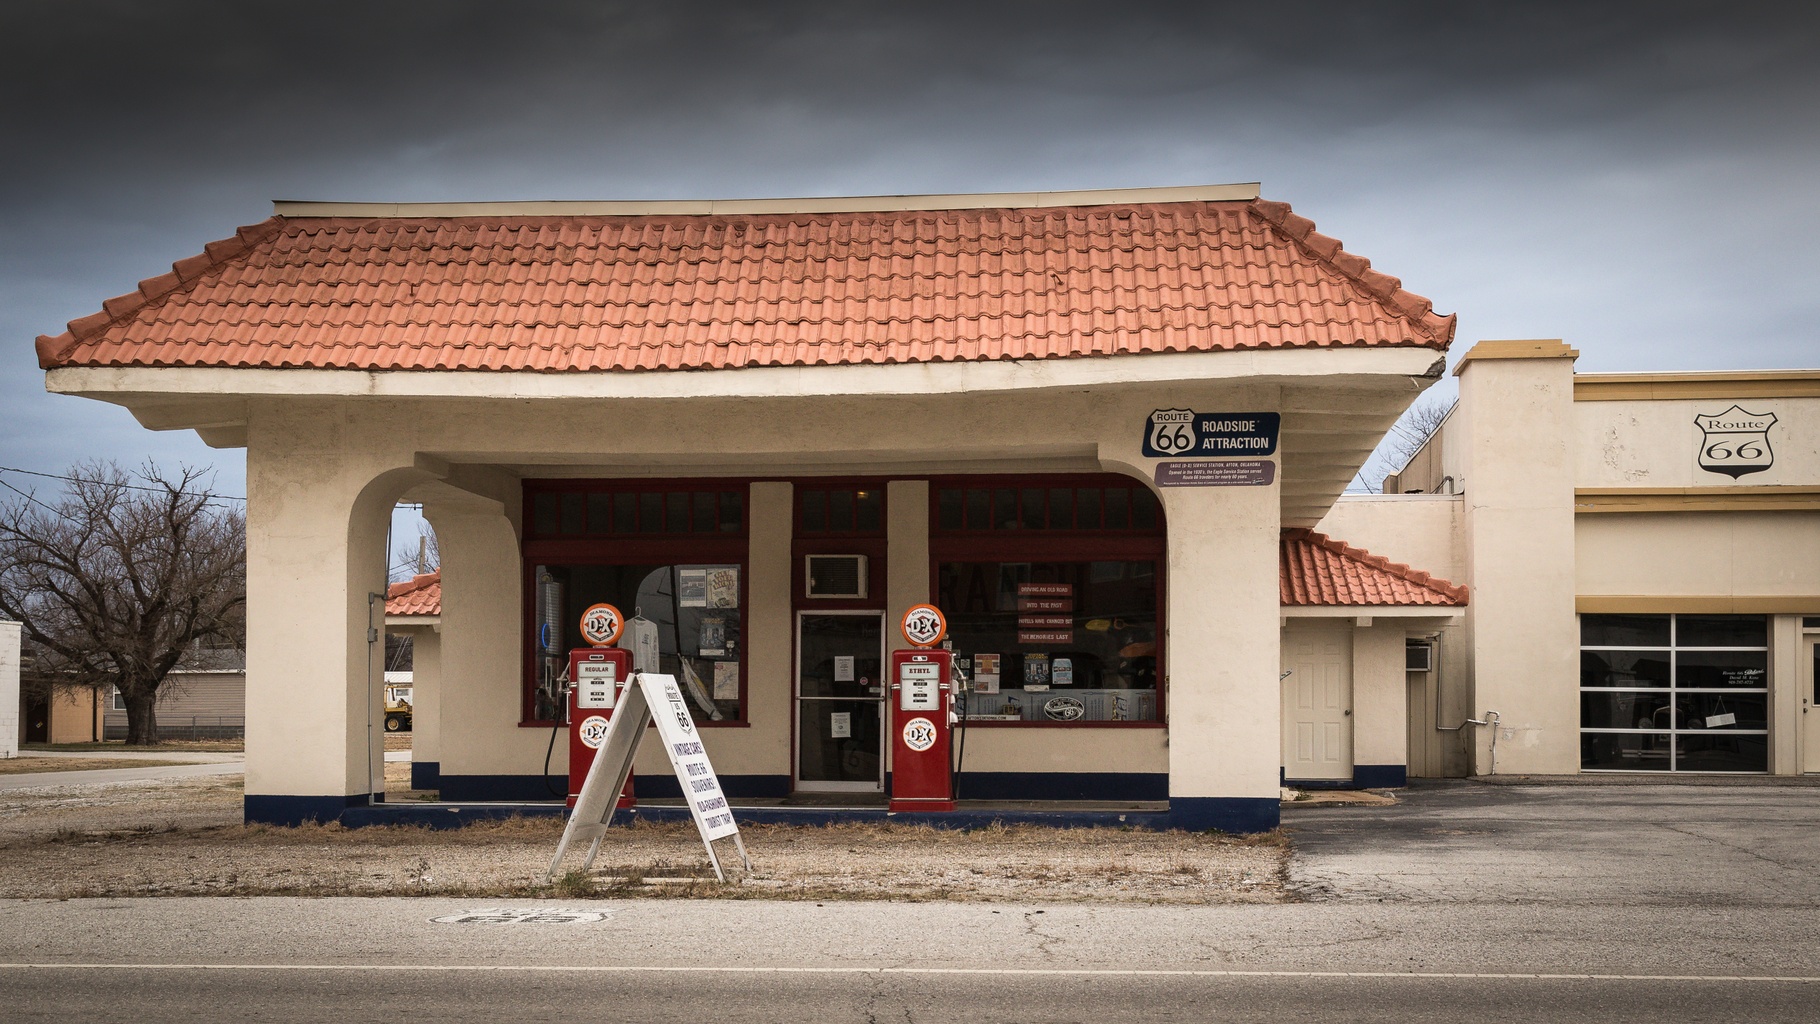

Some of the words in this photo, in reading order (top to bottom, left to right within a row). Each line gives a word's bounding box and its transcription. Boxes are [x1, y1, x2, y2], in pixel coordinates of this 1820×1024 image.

[1157, 413, 1189, 421] ROUTE
[1202, 420, 1255, 432] ROADSIDE
[1707, 420, 1764, 429] Route
[1156, 424, 1190, 450] 66
[1202, 437, 1269, 449] ATTRACTION
[1706, 440, 1763, 459] 66
[677, 712, 689, 727] 66
[674, 743, 692, 756] VINTAGE
[685, 763, 702, 777] ROUTE
[696, 796, 726, 813] OLD-FASHIONED
[705, 815, 722, 829] TOURIST
[720, 812, 732, 825] TRAP
